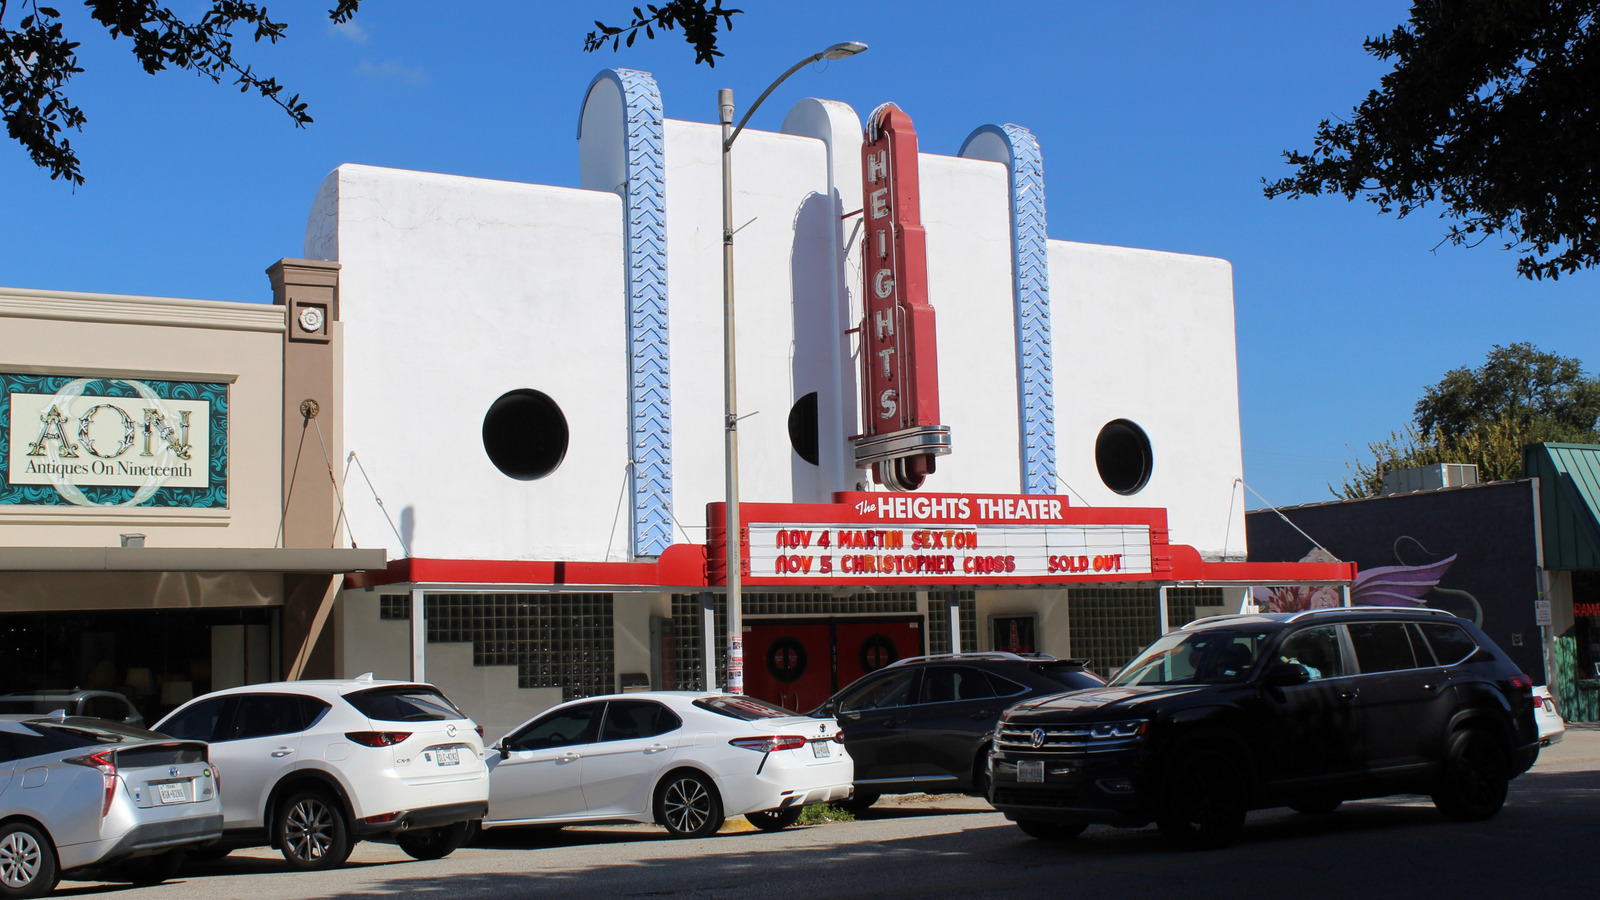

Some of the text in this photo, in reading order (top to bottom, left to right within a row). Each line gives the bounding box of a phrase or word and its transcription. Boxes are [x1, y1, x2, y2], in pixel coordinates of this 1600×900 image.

[866, 148, 898, 420] HEIGHTS
[26, 403, 192, 460] AON
[25, 459, 192, 479] Antiques On Nineteenth
[855, 496, 1063, 520] The HEIGHTS THEATER
[776, 529, 978, 550] NOV 4 MARTIN SEXTON
[775, 555, 1016, 575] NOV 5 CHRISTOPHER CROSS
[1048, 554, 1122, 573] SOLD OUT
